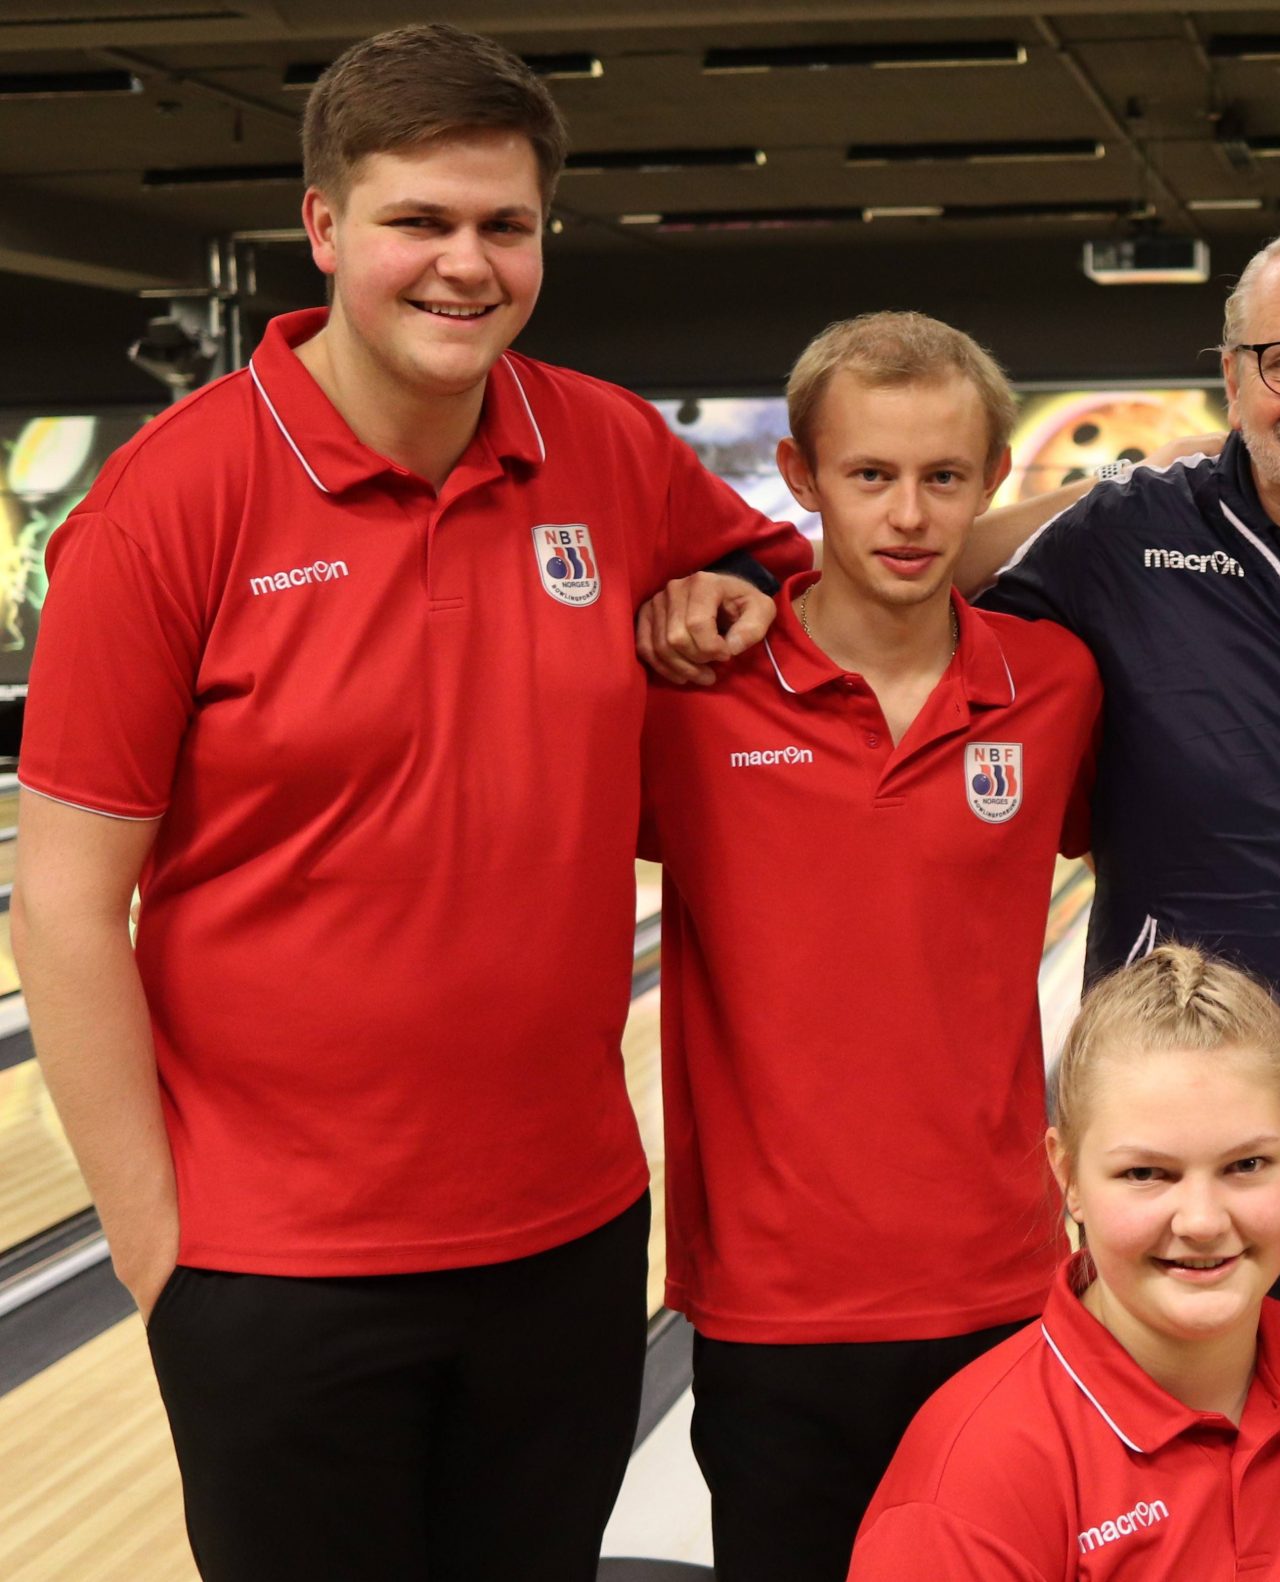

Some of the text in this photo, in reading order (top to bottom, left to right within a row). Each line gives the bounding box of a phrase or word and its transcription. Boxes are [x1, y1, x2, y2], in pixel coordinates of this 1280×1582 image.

[250, 560, 350, 596] macron
[1144, 549, 1245, 577] macron
[730, 746, 813, 767] macron
[1078, 1500, 1169, 1554] macron
